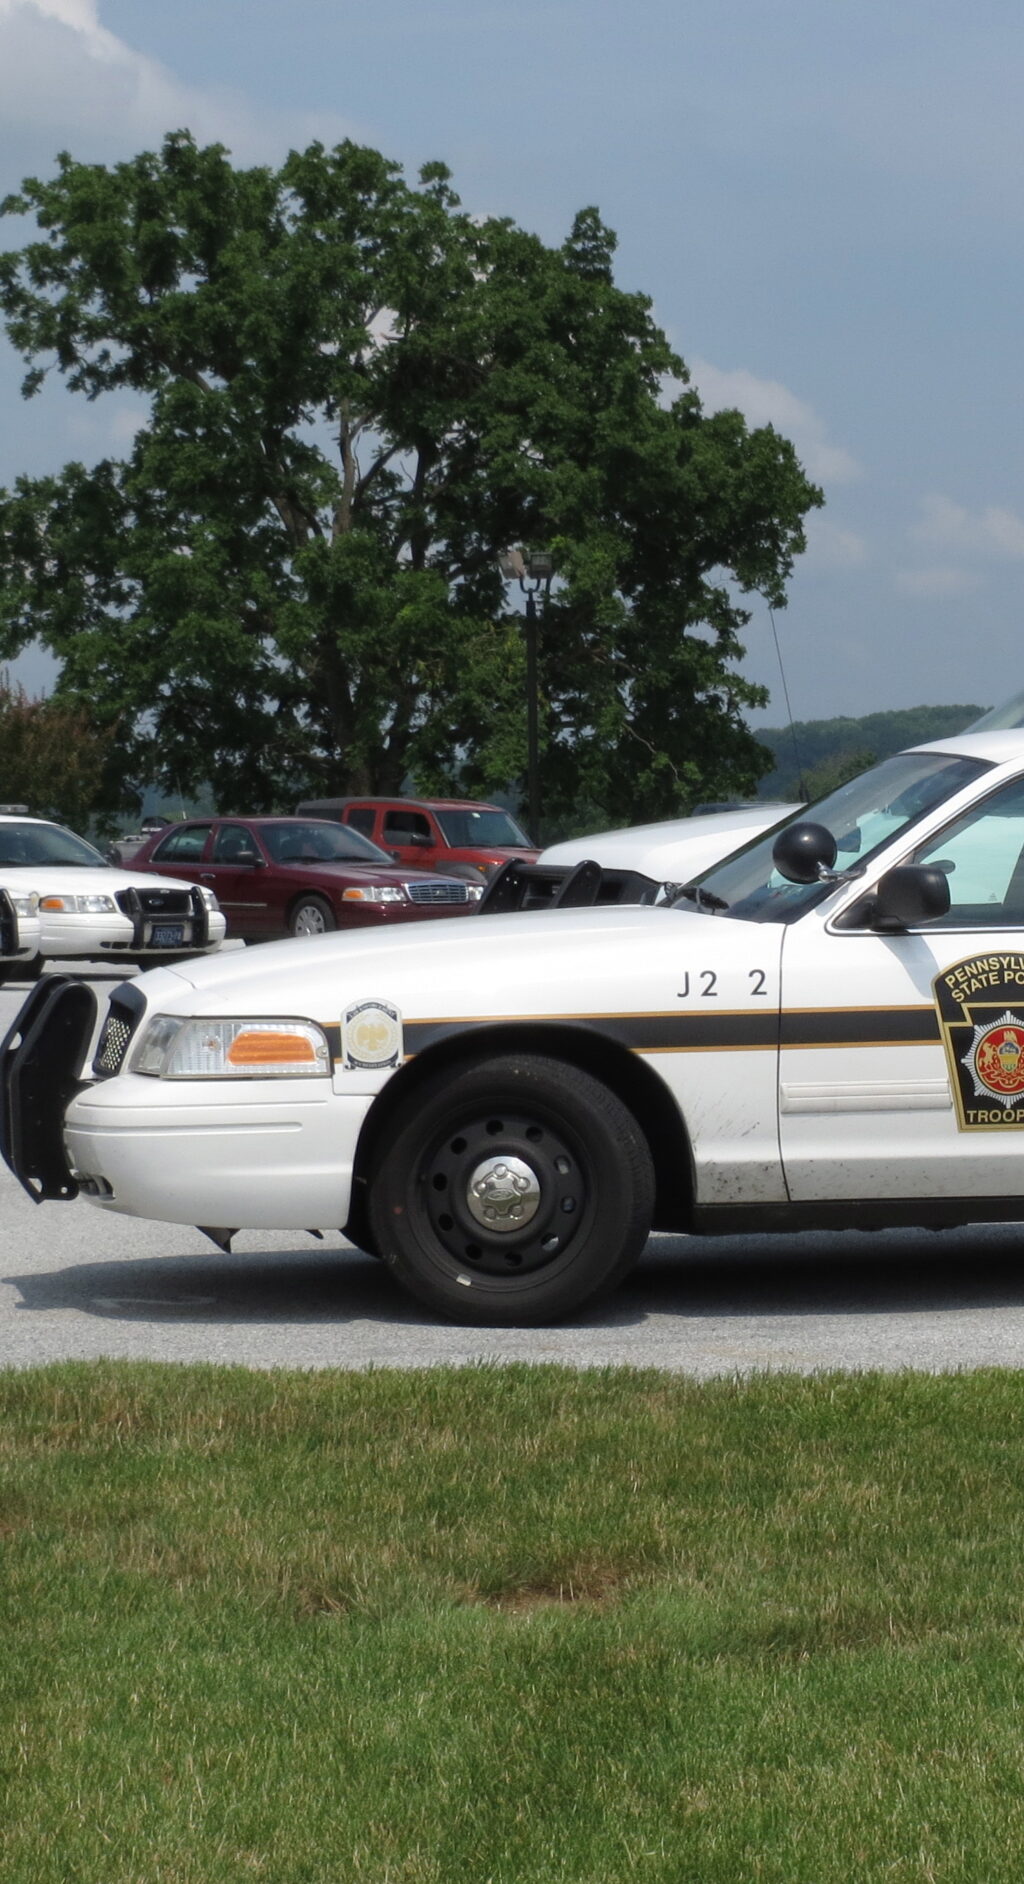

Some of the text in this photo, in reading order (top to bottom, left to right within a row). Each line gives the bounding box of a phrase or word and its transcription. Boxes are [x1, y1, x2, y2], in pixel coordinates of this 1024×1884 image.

[676, 968, 768, 998] J2 2
[951, 971, 1001, 1002] STATE
